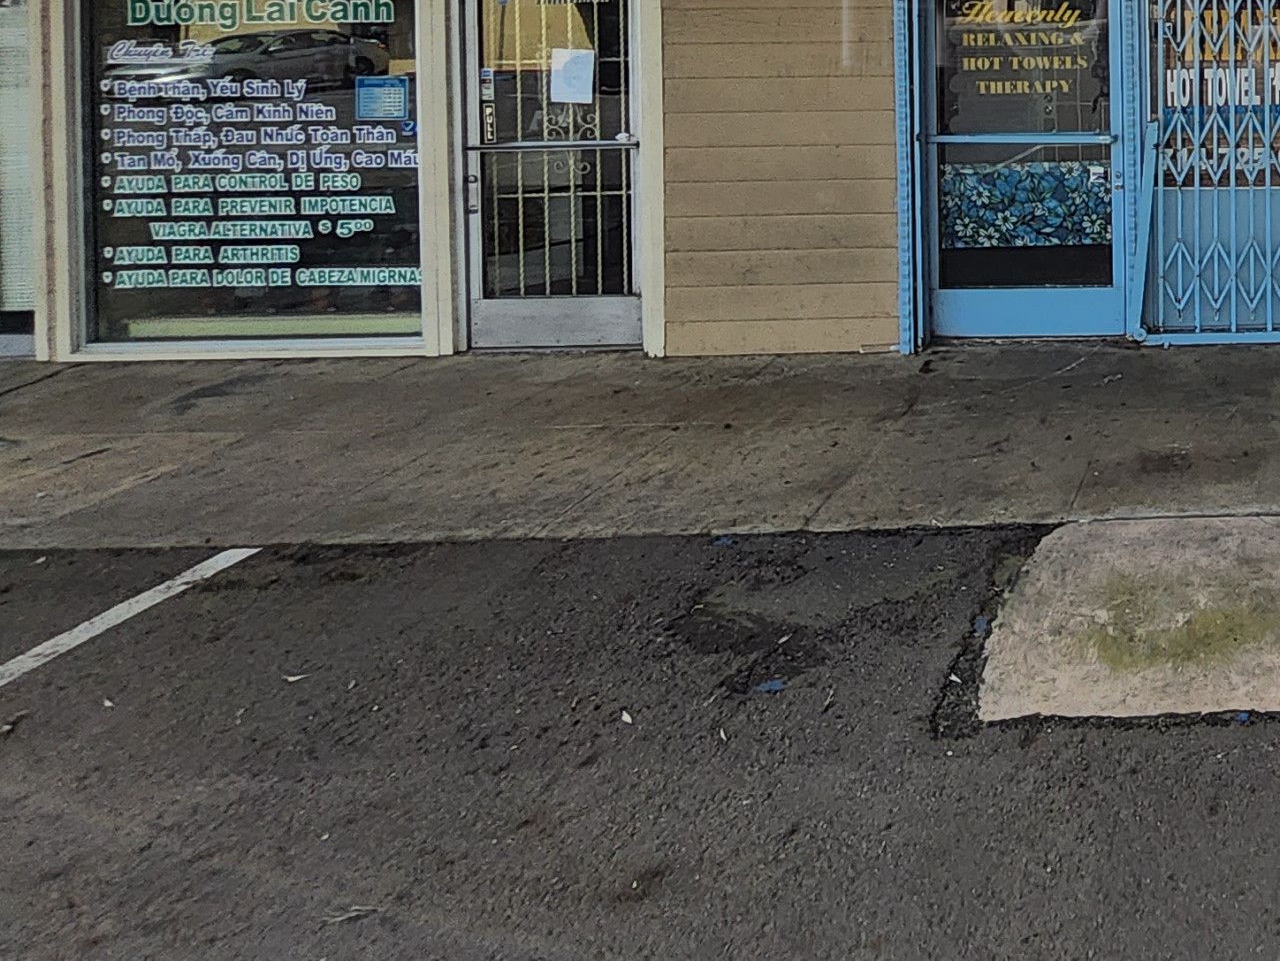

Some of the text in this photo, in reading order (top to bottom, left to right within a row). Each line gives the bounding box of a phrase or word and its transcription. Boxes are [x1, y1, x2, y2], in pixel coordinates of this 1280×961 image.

[959, 0, 1082, 29] Heavenly
[961, 31, 1086, 47] RELAXING &
[961, 55, 1088, 71] HOT TOWELS
[243, 78, 281, 97] Sinh
[975, 79, 1073, 95] THERAPY
[113, 104, 167, 125] Phong
[485, 107, 494, 140] PULL
[113, 128, 167, 149] Phong
[220, 127, 257, 145] Đau
[114, 152, 148, 170] Tan
[351, 150, 386, 168] Cao
[113, 172, 362, 193] AYUDA PARA CONTROL DE PESO
[113, 195, 396, 217] AYUDA PARA PREVENIR IMPOTENCIA
[150, 221, 209, 240] VIAGRA
[210, 220, 314, 239] ALTERNATIVA
[113, 245, 300, 264] AYUDA PARA ARTHRITIS
[114, 266, 422, 288] AYUDA PARA DOLOR DE CABEZA MIGRNA
